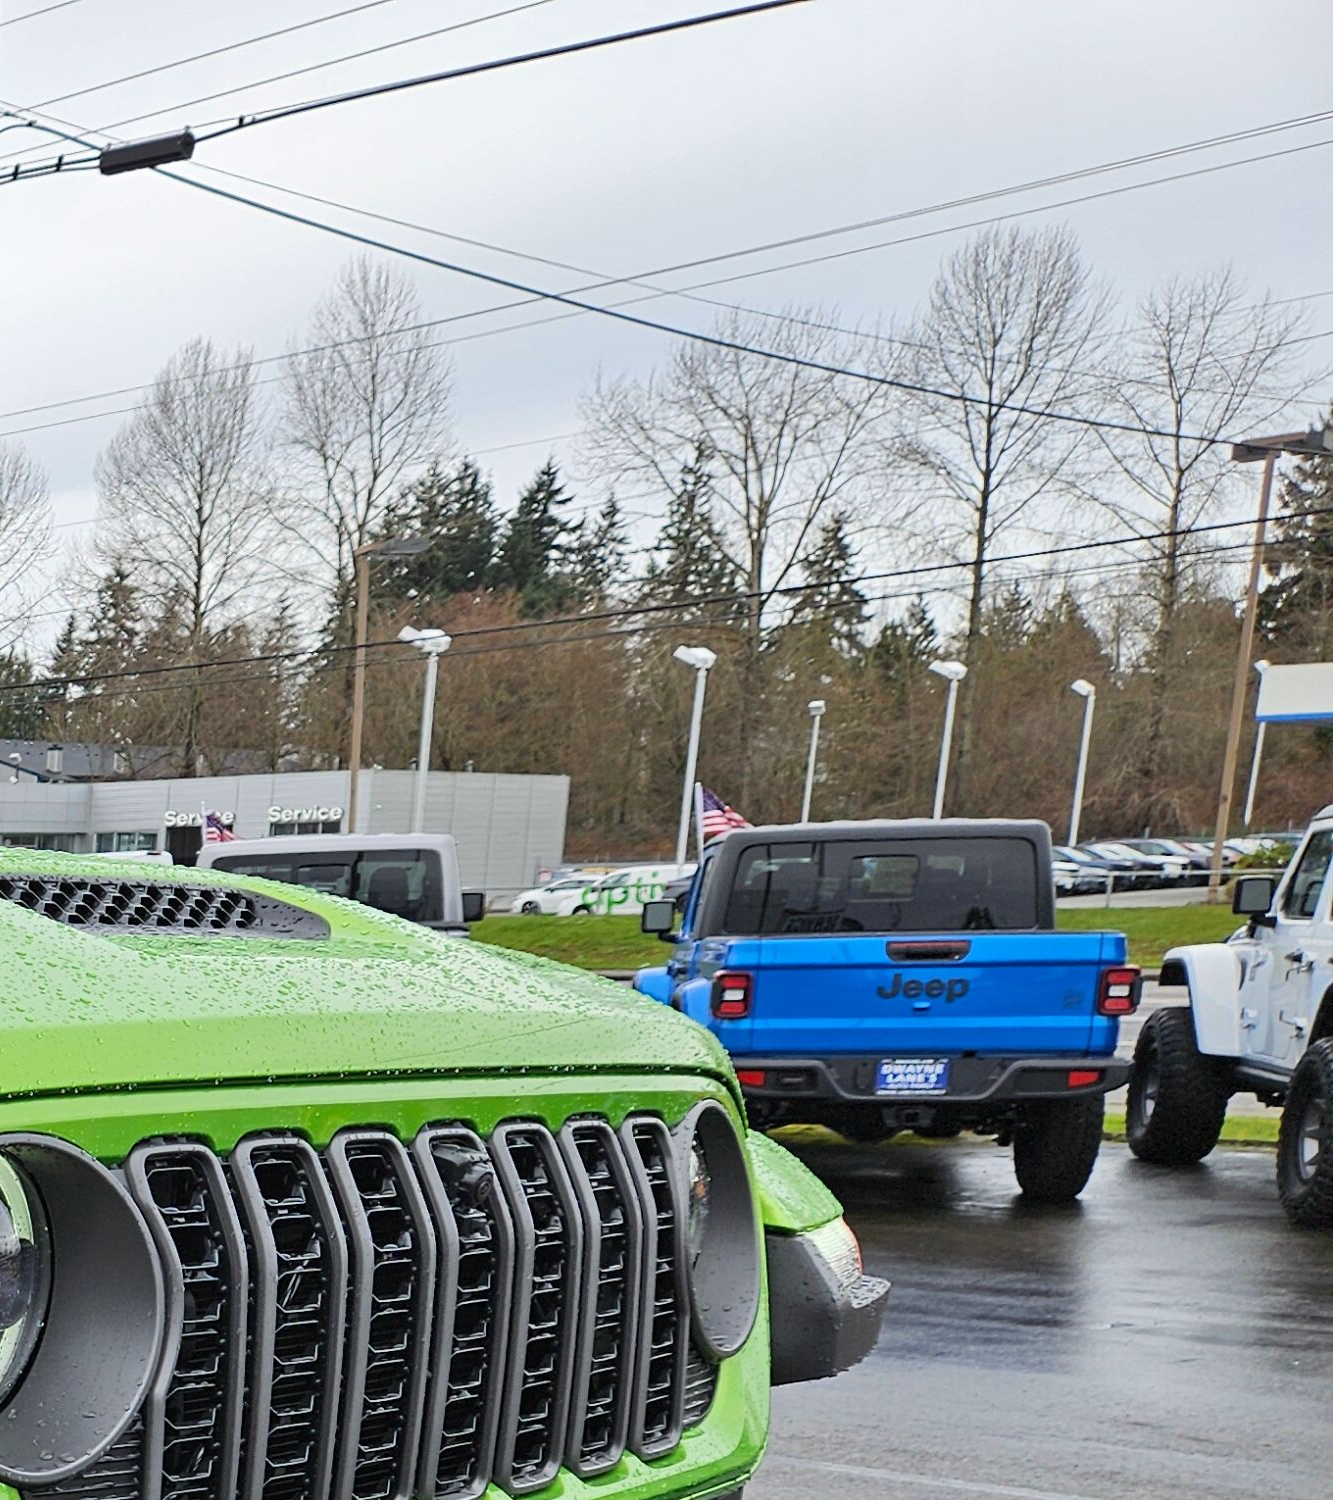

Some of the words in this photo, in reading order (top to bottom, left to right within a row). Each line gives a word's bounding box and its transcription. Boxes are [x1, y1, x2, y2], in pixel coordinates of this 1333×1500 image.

[164, 810, 236, 827] Serve
[268, 805, 343, 823] Service
[877, 972, 970, 1002] Jeep
